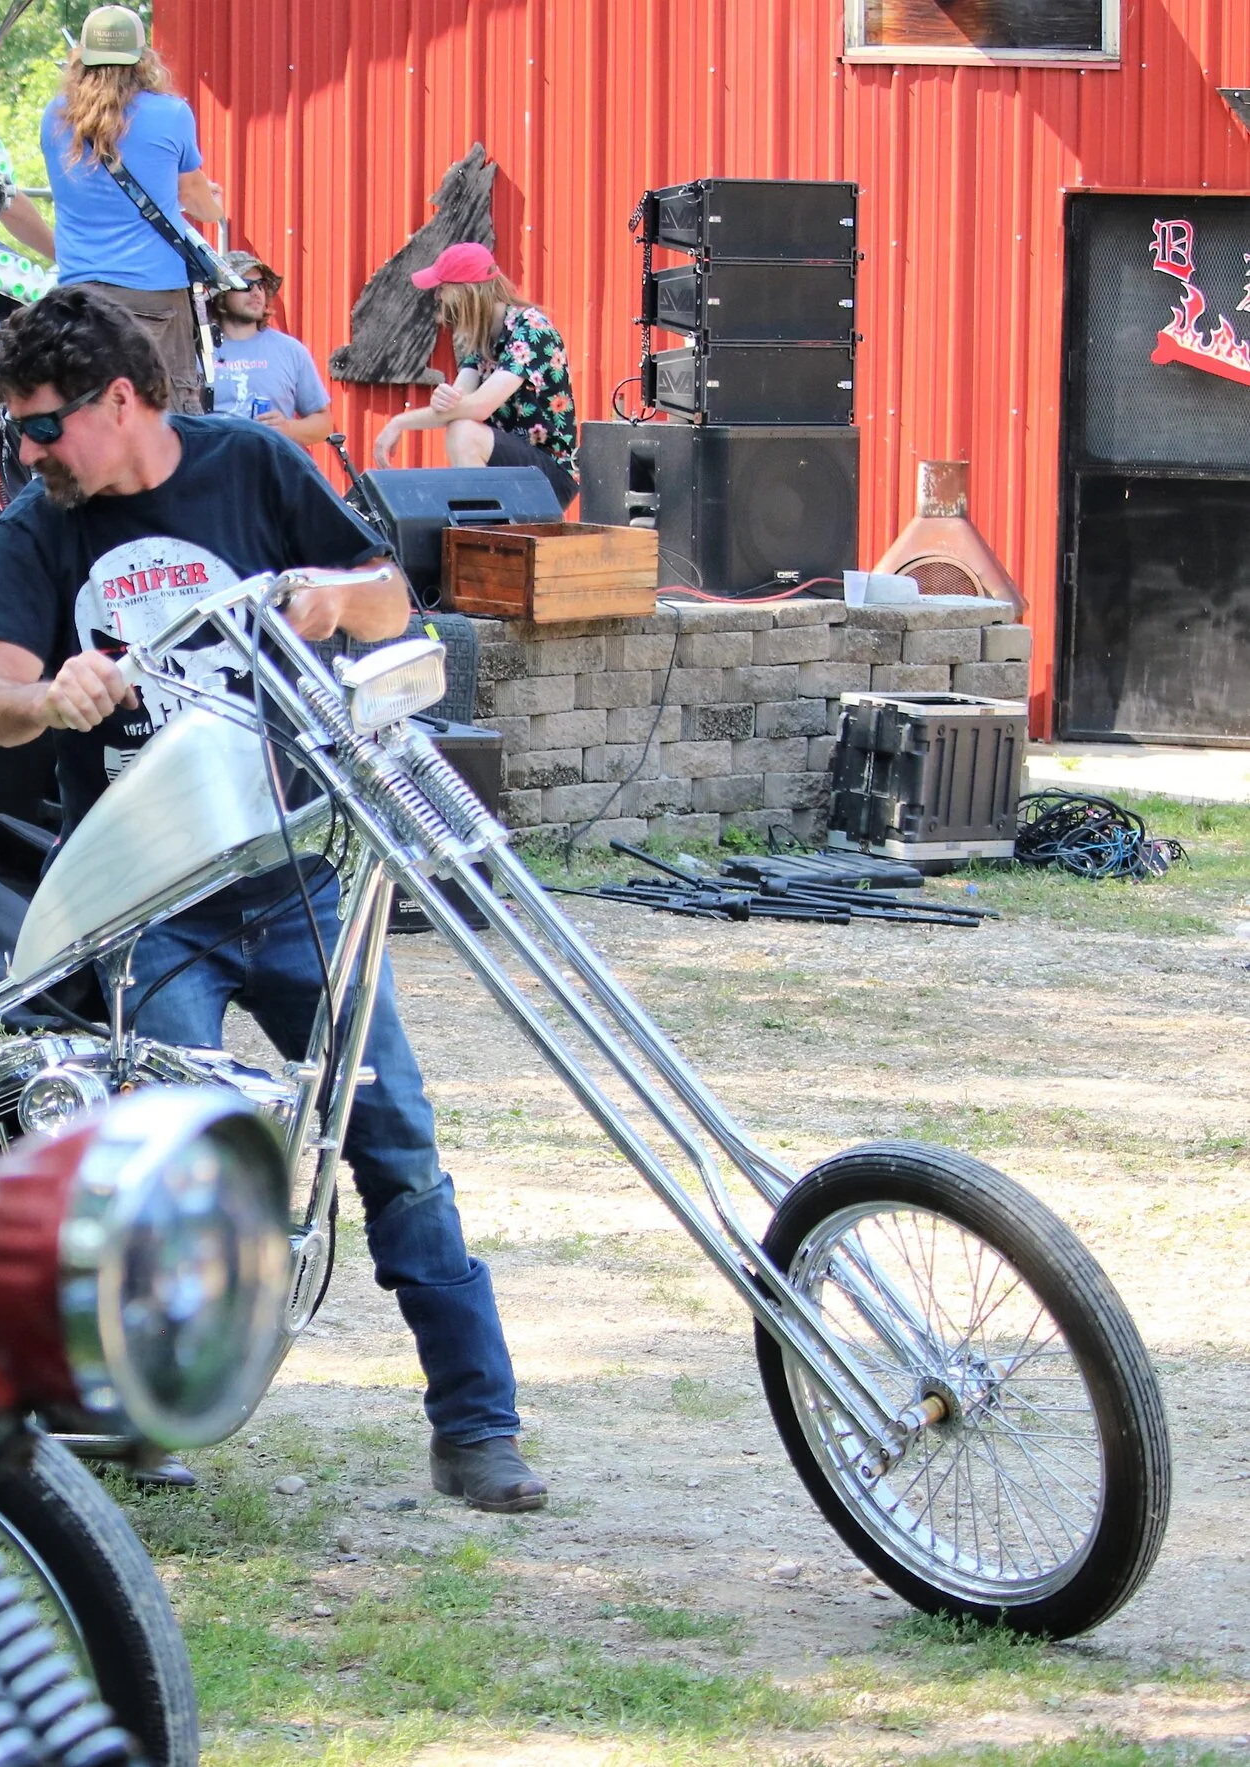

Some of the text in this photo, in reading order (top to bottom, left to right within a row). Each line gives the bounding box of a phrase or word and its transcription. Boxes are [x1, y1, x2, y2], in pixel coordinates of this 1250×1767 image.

[102, 562, 209, 600] SNIPER
[106, 601, 123, 609] ONE
[160, 590, 177, 598] ONE
[123, 721, 151, 736] 1974
